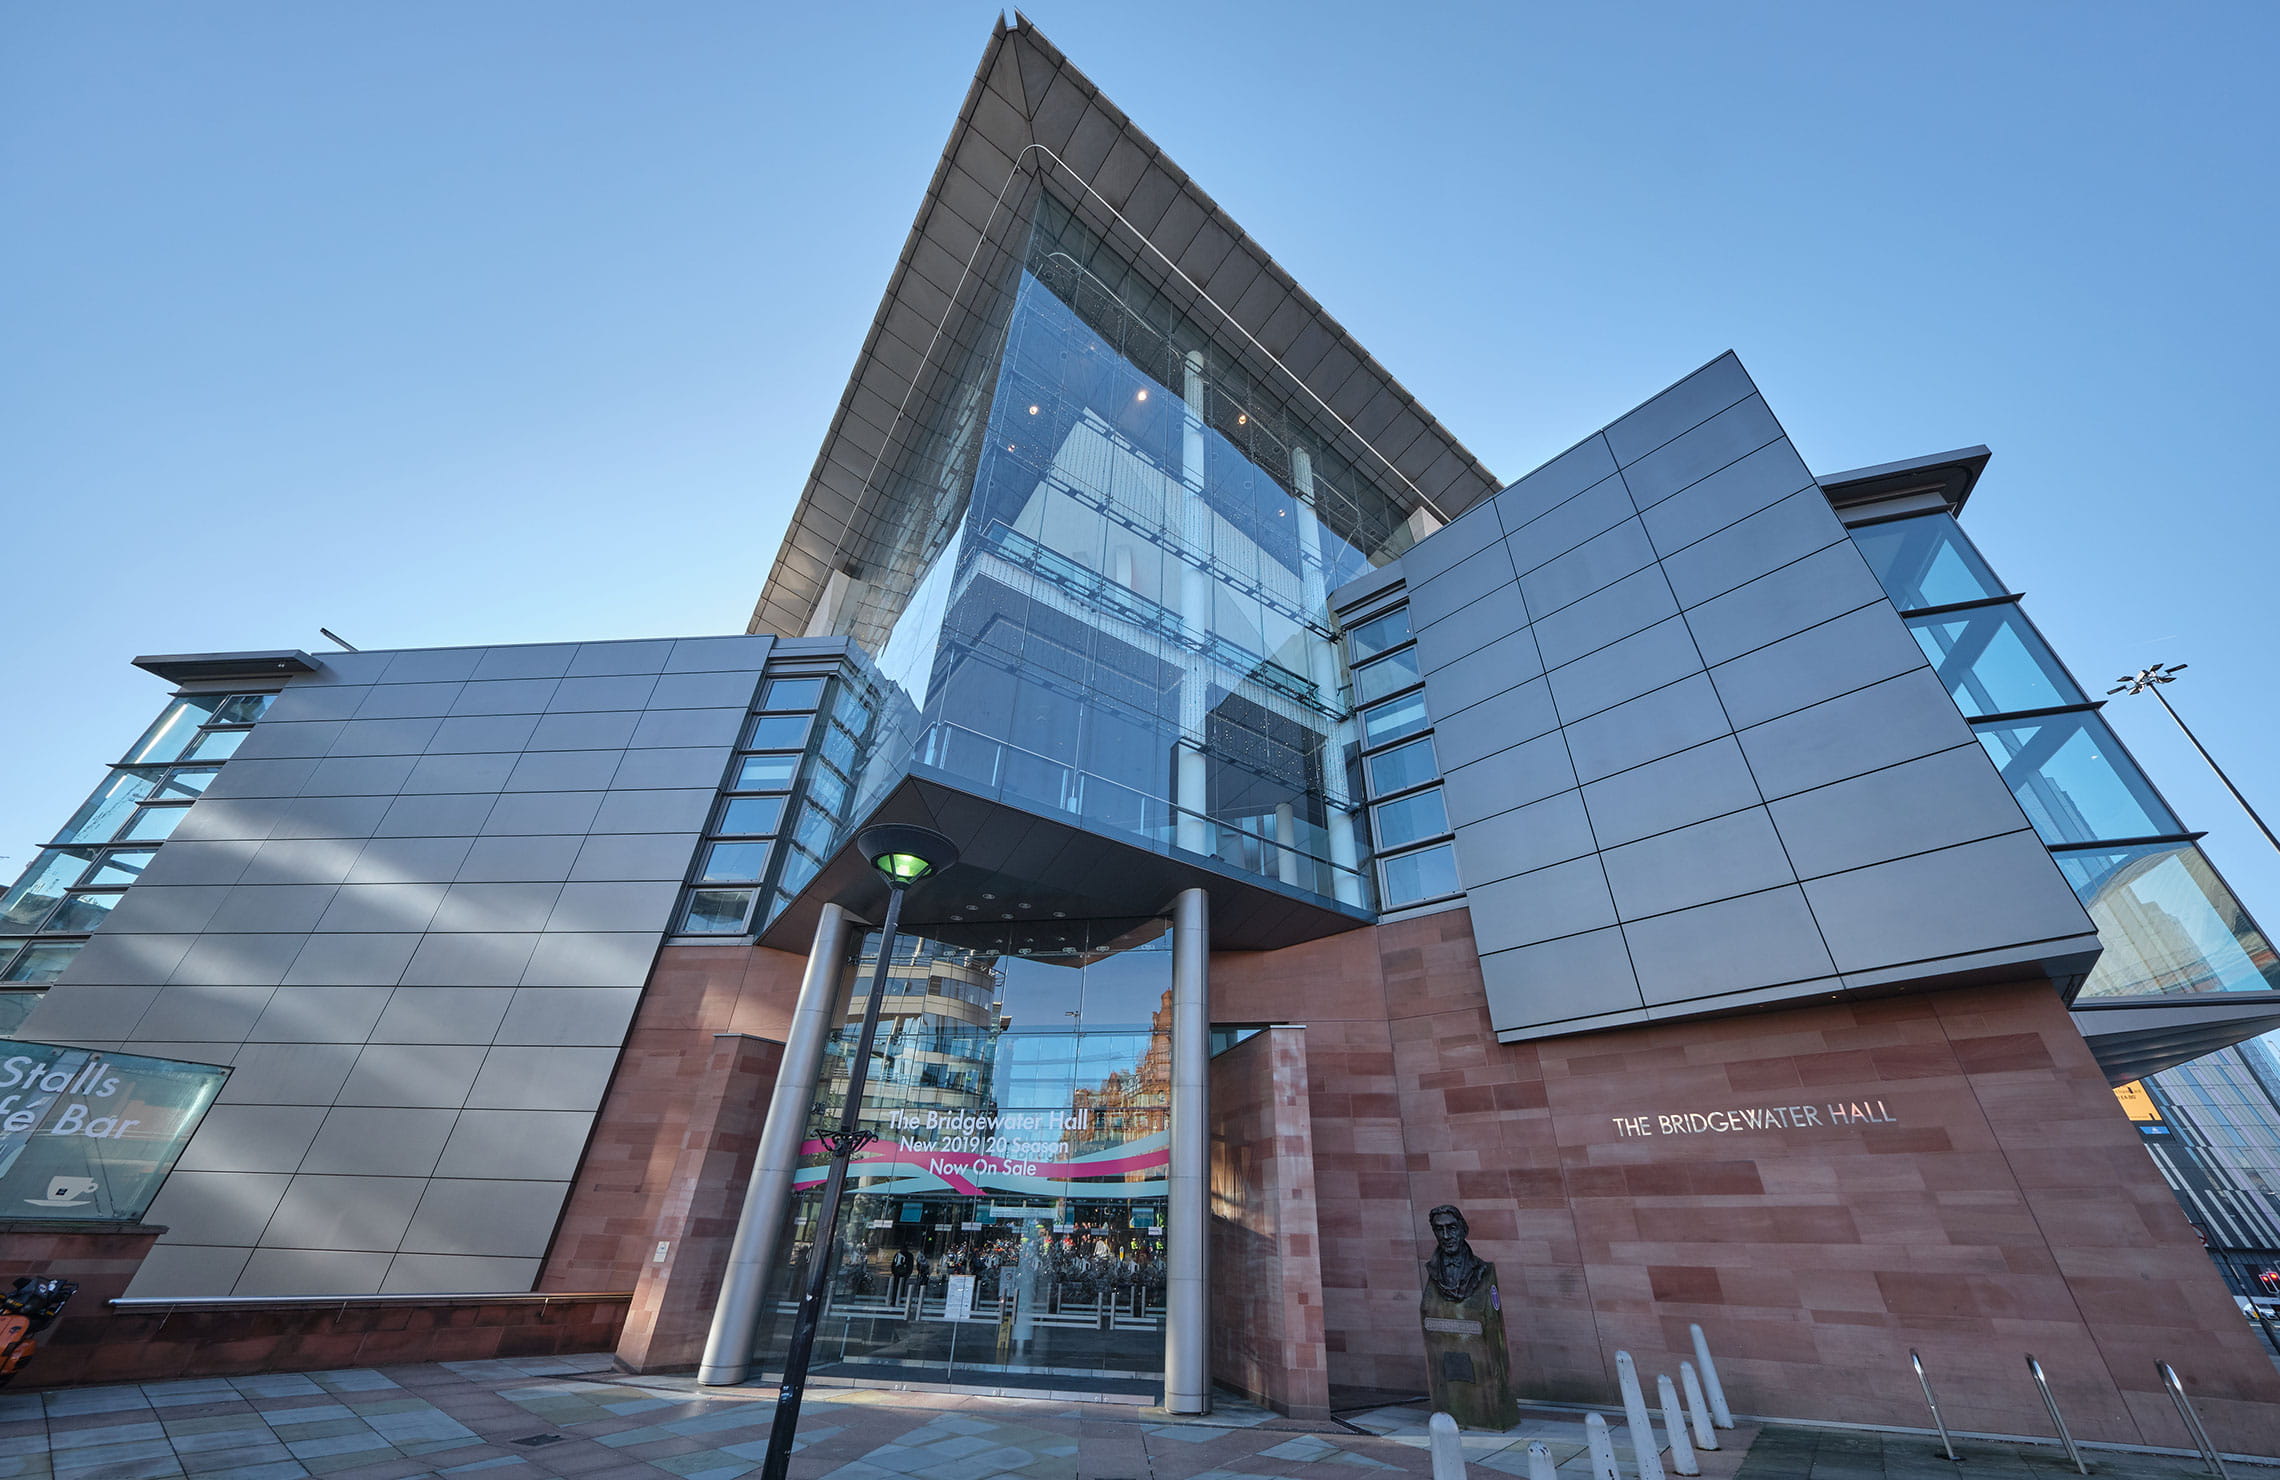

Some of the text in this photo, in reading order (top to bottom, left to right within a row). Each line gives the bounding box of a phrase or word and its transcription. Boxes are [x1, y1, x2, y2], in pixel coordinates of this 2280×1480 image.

[0, 1056, 120, 1097] Stalls
[51, 1103, 141, 1139] Bar
[889, 1108, 1088, 1135] The Bridgewater Hall
[1612, 1100, 1897, 1136] THE BRIDGEWATER HALL
[900, 1136, 936, 1152] New
[1012, 1139, 1069, 1153] Season
[929, 1157, 1036, 1176] Now On Sale
